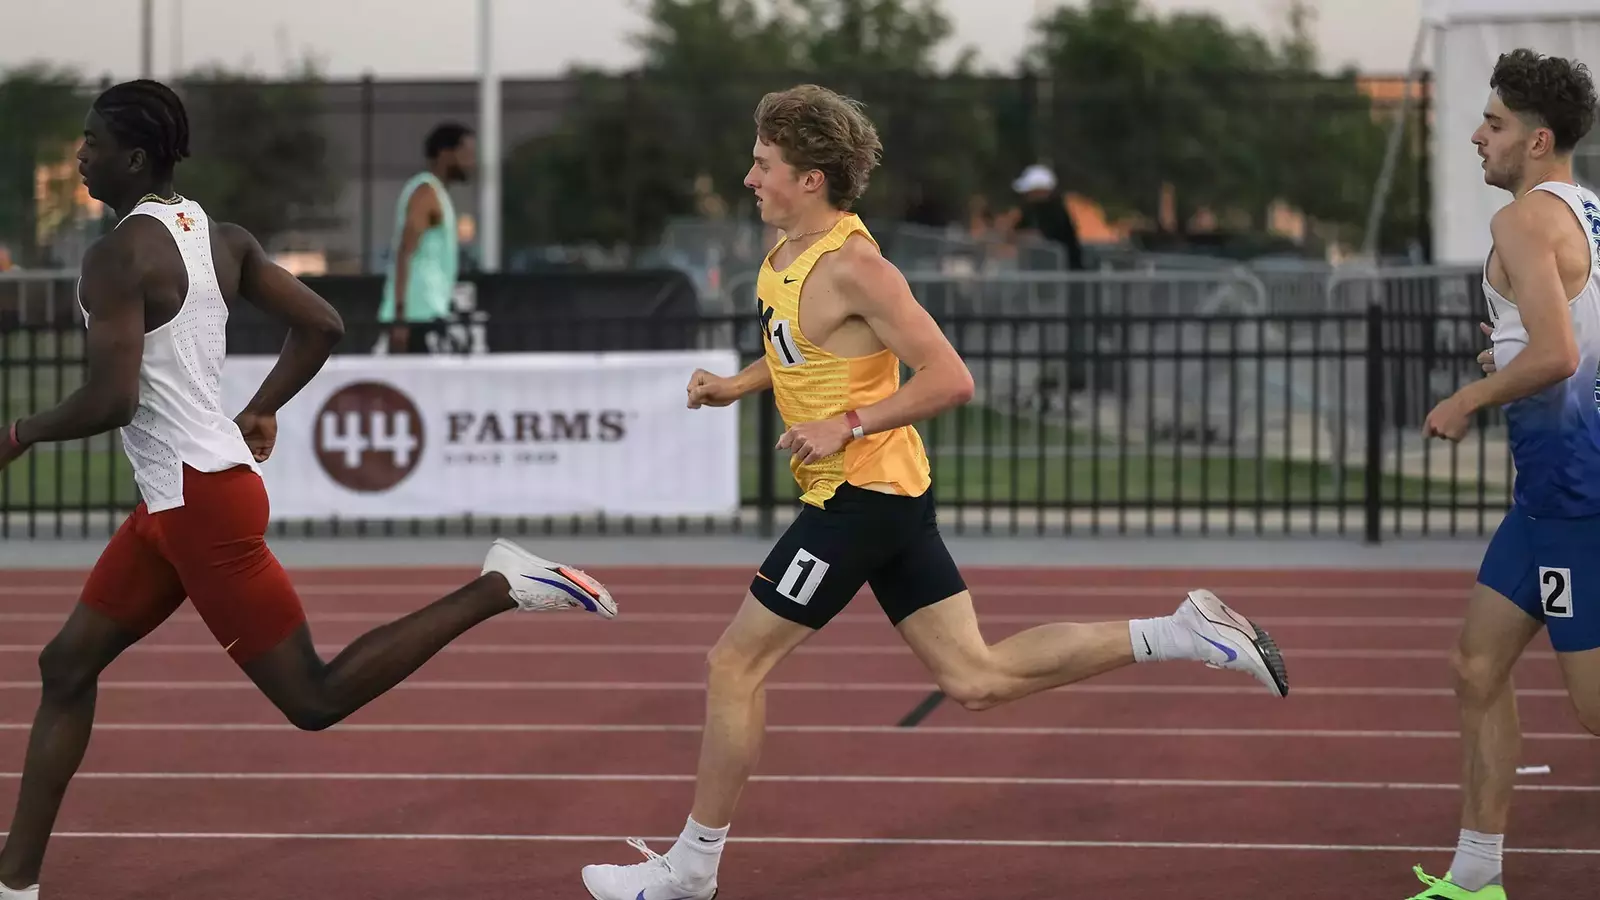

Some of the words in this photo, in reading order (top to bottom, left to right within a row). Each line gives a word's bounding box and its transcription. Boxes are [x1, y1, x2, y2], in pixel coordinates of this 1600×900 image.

[773, 322, 796, 364] 1
[320, 409, 418, 470] 44
[446, 410, 626, 444] FARMS
[788, 558, 817, 599] 1
[1543, 570, 1567, 614] 2
